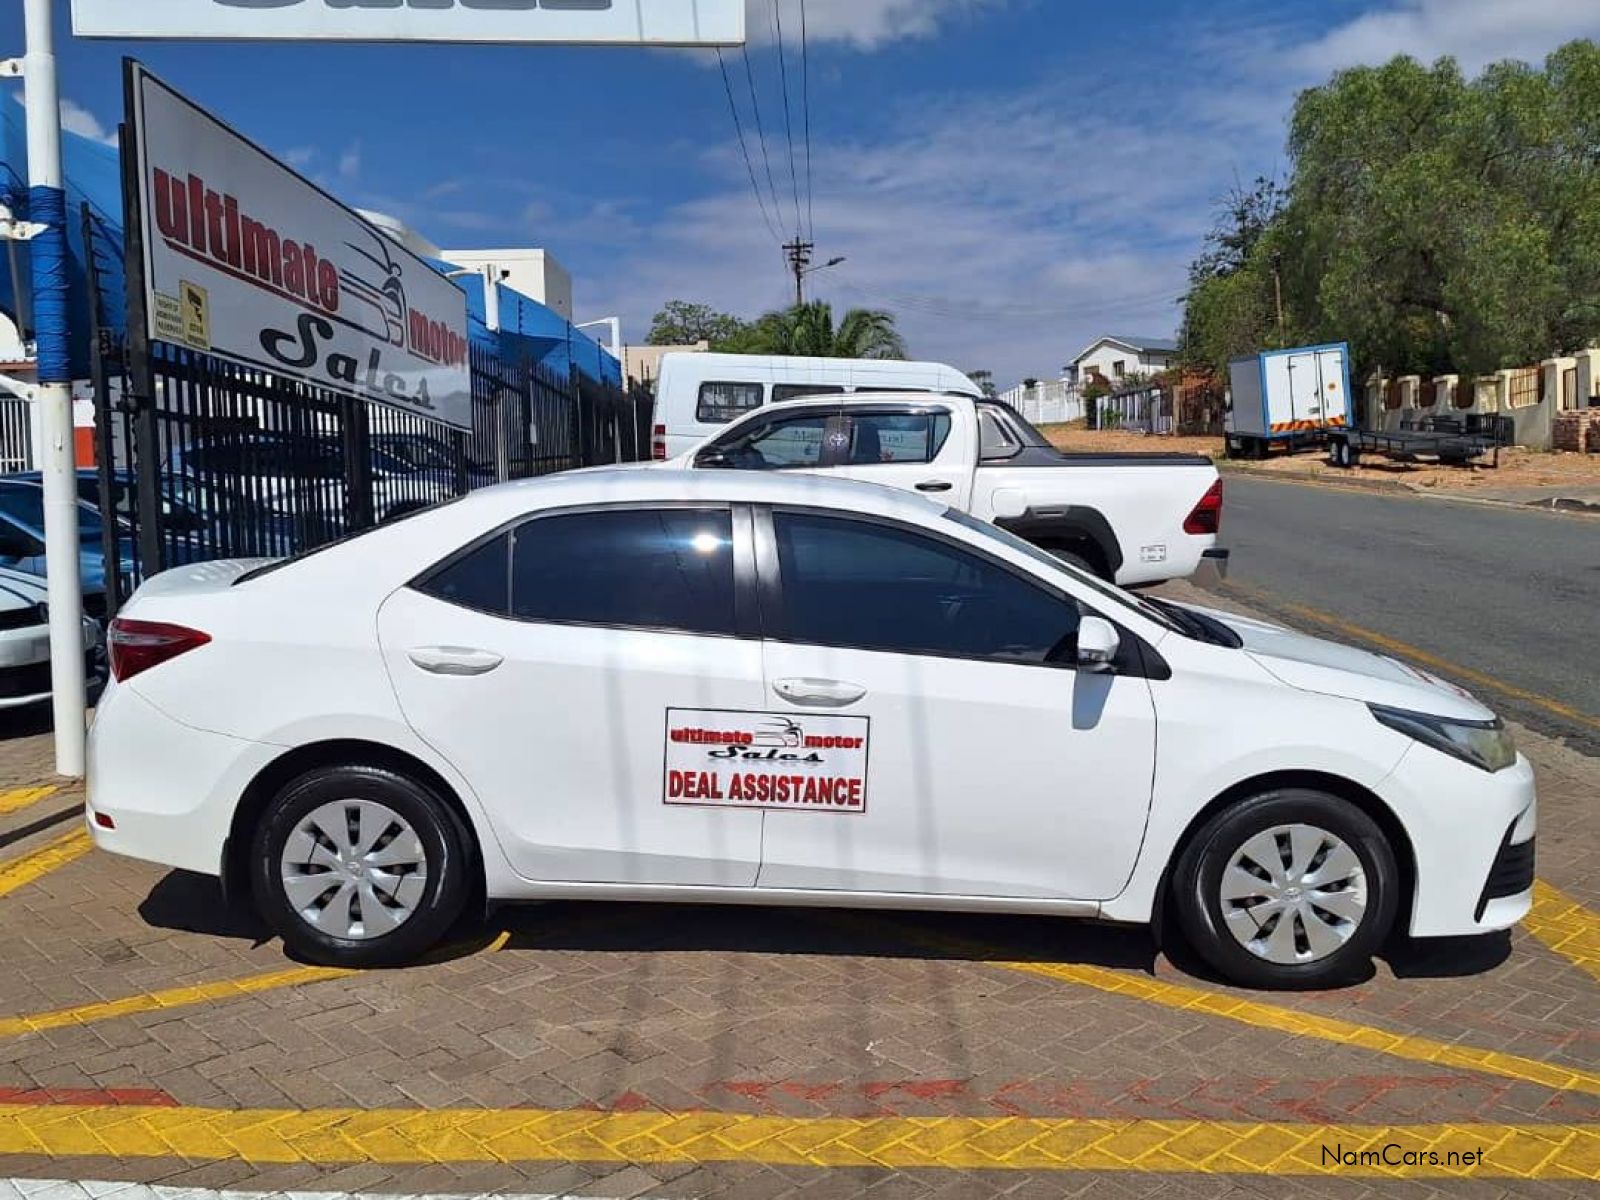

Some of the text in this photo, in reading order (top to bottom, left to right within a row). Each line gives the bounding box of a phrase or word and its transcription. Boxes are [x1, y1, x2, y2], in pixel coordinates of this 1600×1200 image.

[153, 167, 467, 370] ultimate motor
[259, 313, 435, 410] Sales
[670, 728, 864, 749] ultimate motor
[708, 745, 825, 762] Sales
[669, 770, 861, 806] DEAL ASSISTANCE
